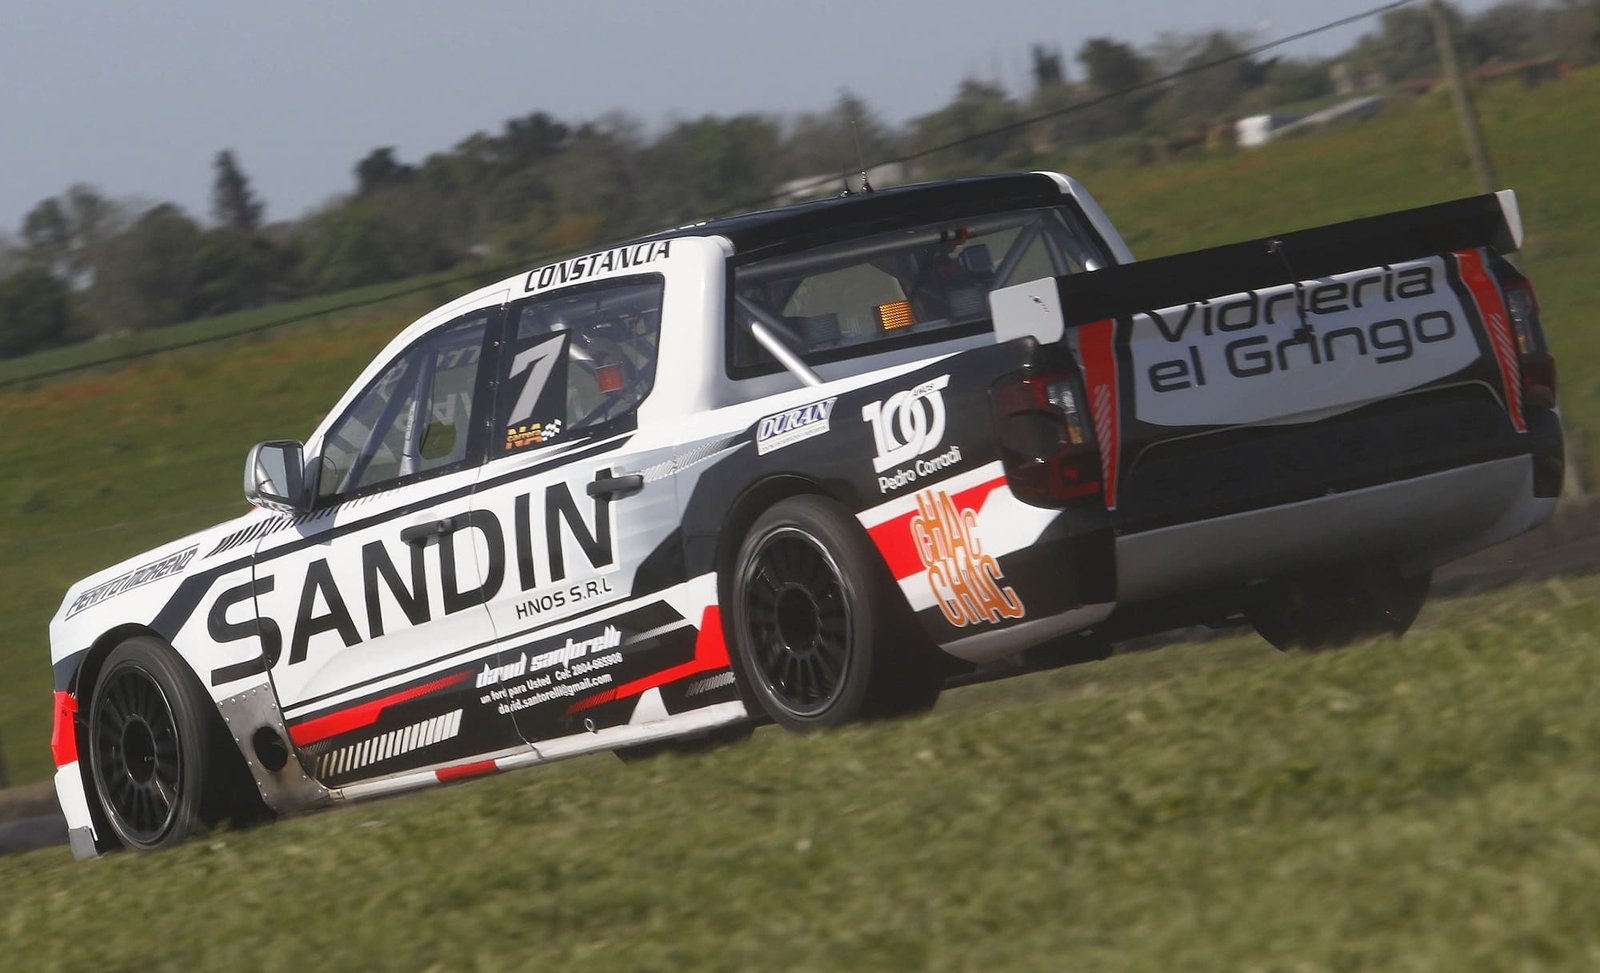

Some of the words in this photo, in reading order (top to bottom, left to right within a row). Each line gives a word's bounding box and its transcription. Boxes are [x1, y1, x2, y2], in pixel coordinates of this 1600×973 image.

[524, 240, 671, 293] CONSTANCIA
[506, 333, 567, 427] 7
[1148, 345, 1207, 393] el
[1225, 310, 1457, 379] Gringo
[758, 401, 829, 442] DURAN
[862, 375, 950, 474] 100
[877, 468, 917, 494] Pedro
[915, 445, 963, 478] Corradi
[909, 489, 983, 568] CHAC
[207, 467, 615, 687] SANDIN
[515, 589, 565, 620] HNOS
[569, 576, 612, 602] S.R.L
[928, 553, 1026, 628] CHAC
[475, 652, 528, 689] david
[508, 684, 527, 699] para
[526, 674, 552, 691] Usted
